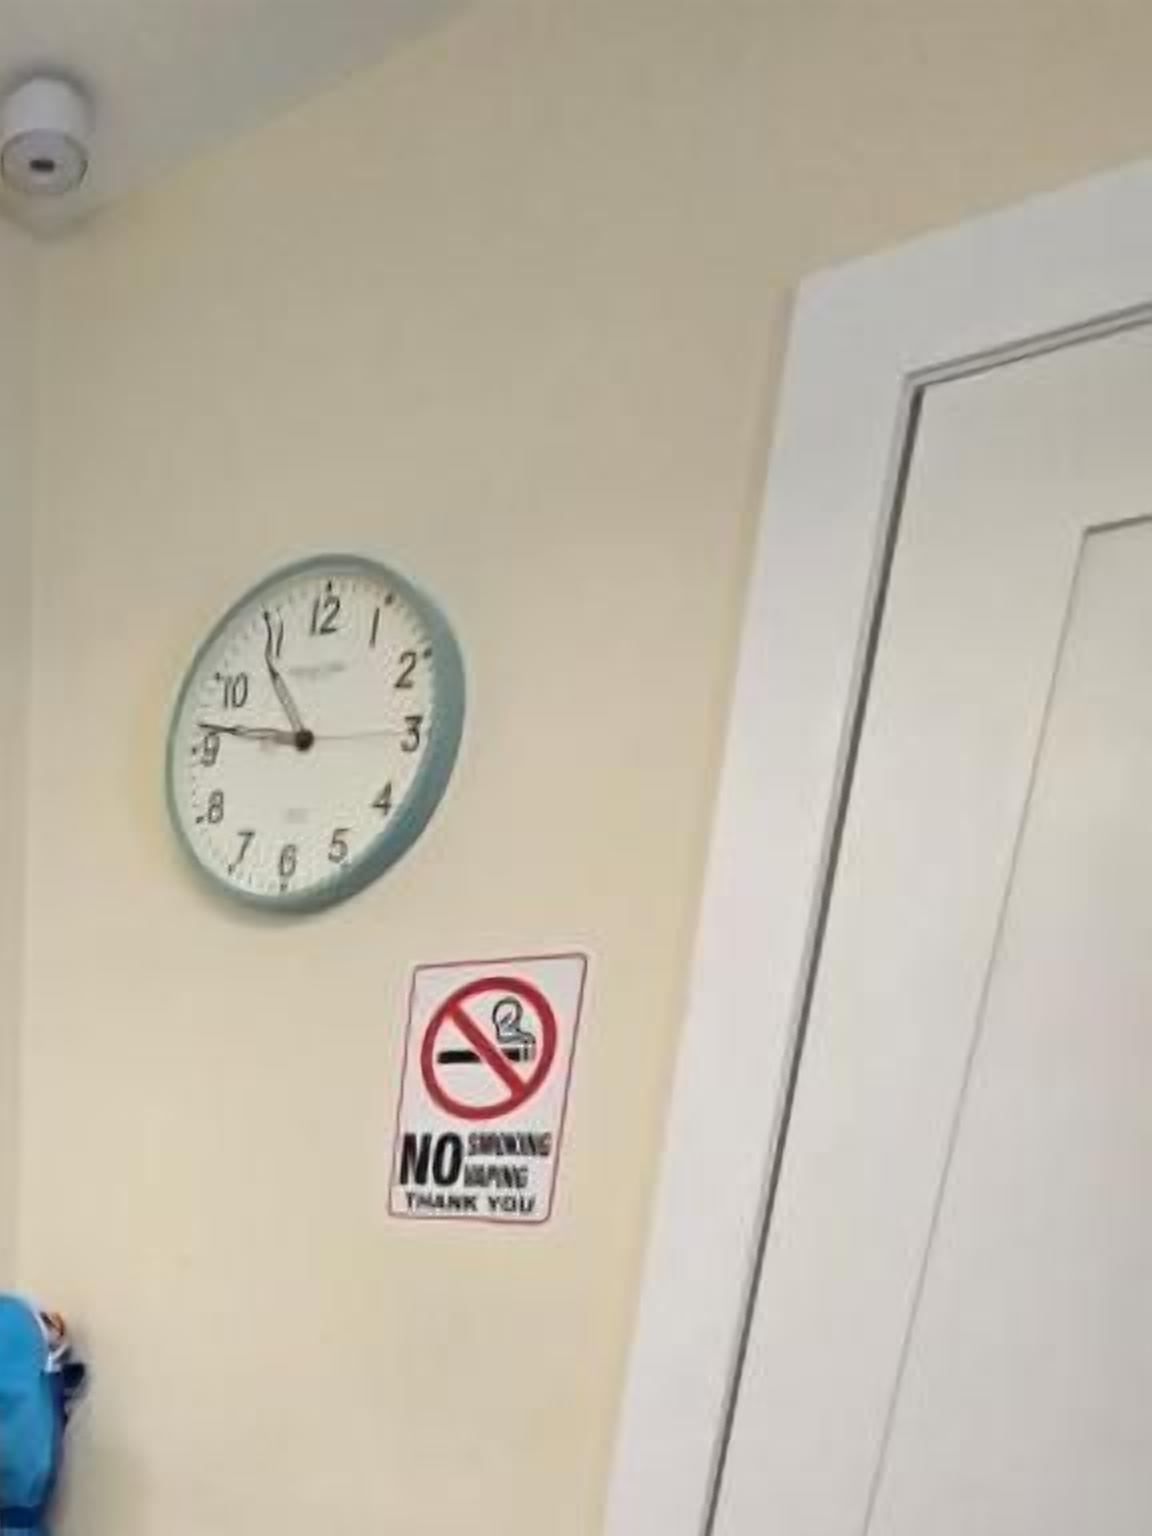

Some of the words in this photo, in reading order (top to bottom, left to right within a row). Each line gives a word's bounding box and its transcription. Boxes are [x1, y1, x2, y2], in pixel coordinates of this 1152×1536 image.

[309, 597, 340, 635] 12
[369, 607, 380, 648] 1
[395, 651, 417, 688] 2
[220, 672, 249, 709] 10
[199, 731, 220, 766] 9
[400, 715, 423, 752] 3
[207, 789, 224, 824] 8
[371, 782, 392, 815] 4
[234, 832, 255, 866] 7
[278, 845, 297, 878] 6
[328, 828, 350, 862] 5
[400, 1132, 464, 1186] NO
[406, 1192, 478, 1212] THANK
[488, 1195, 536, 1212] YOU
